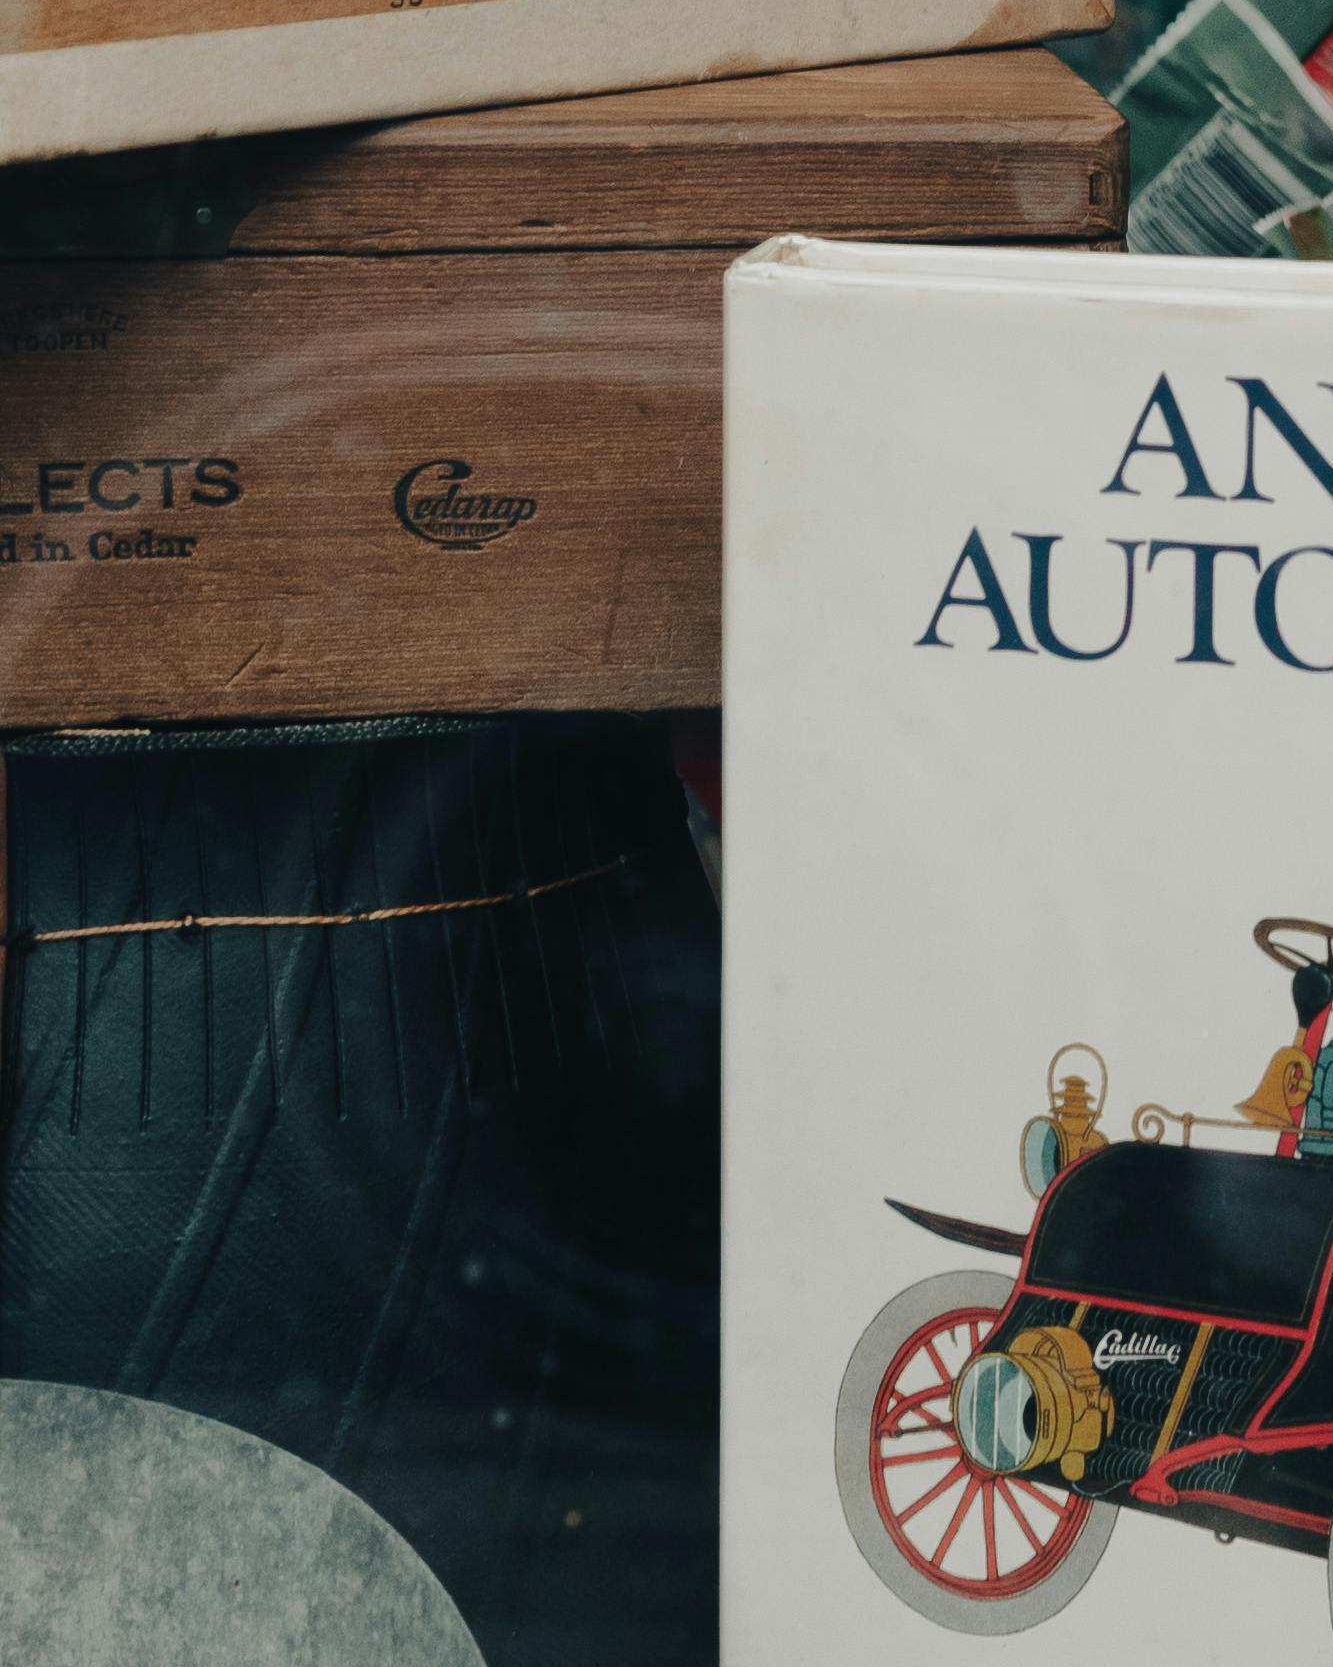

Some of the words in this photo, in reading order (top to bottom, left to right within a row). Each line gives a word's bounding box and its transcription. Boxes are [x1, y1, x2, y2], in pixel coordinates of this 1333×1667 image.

[32, 533, 74, 561] in
[89, 528, 198, 560] Cedar
[1093, 1329, 1181, 1370] Cadillac
